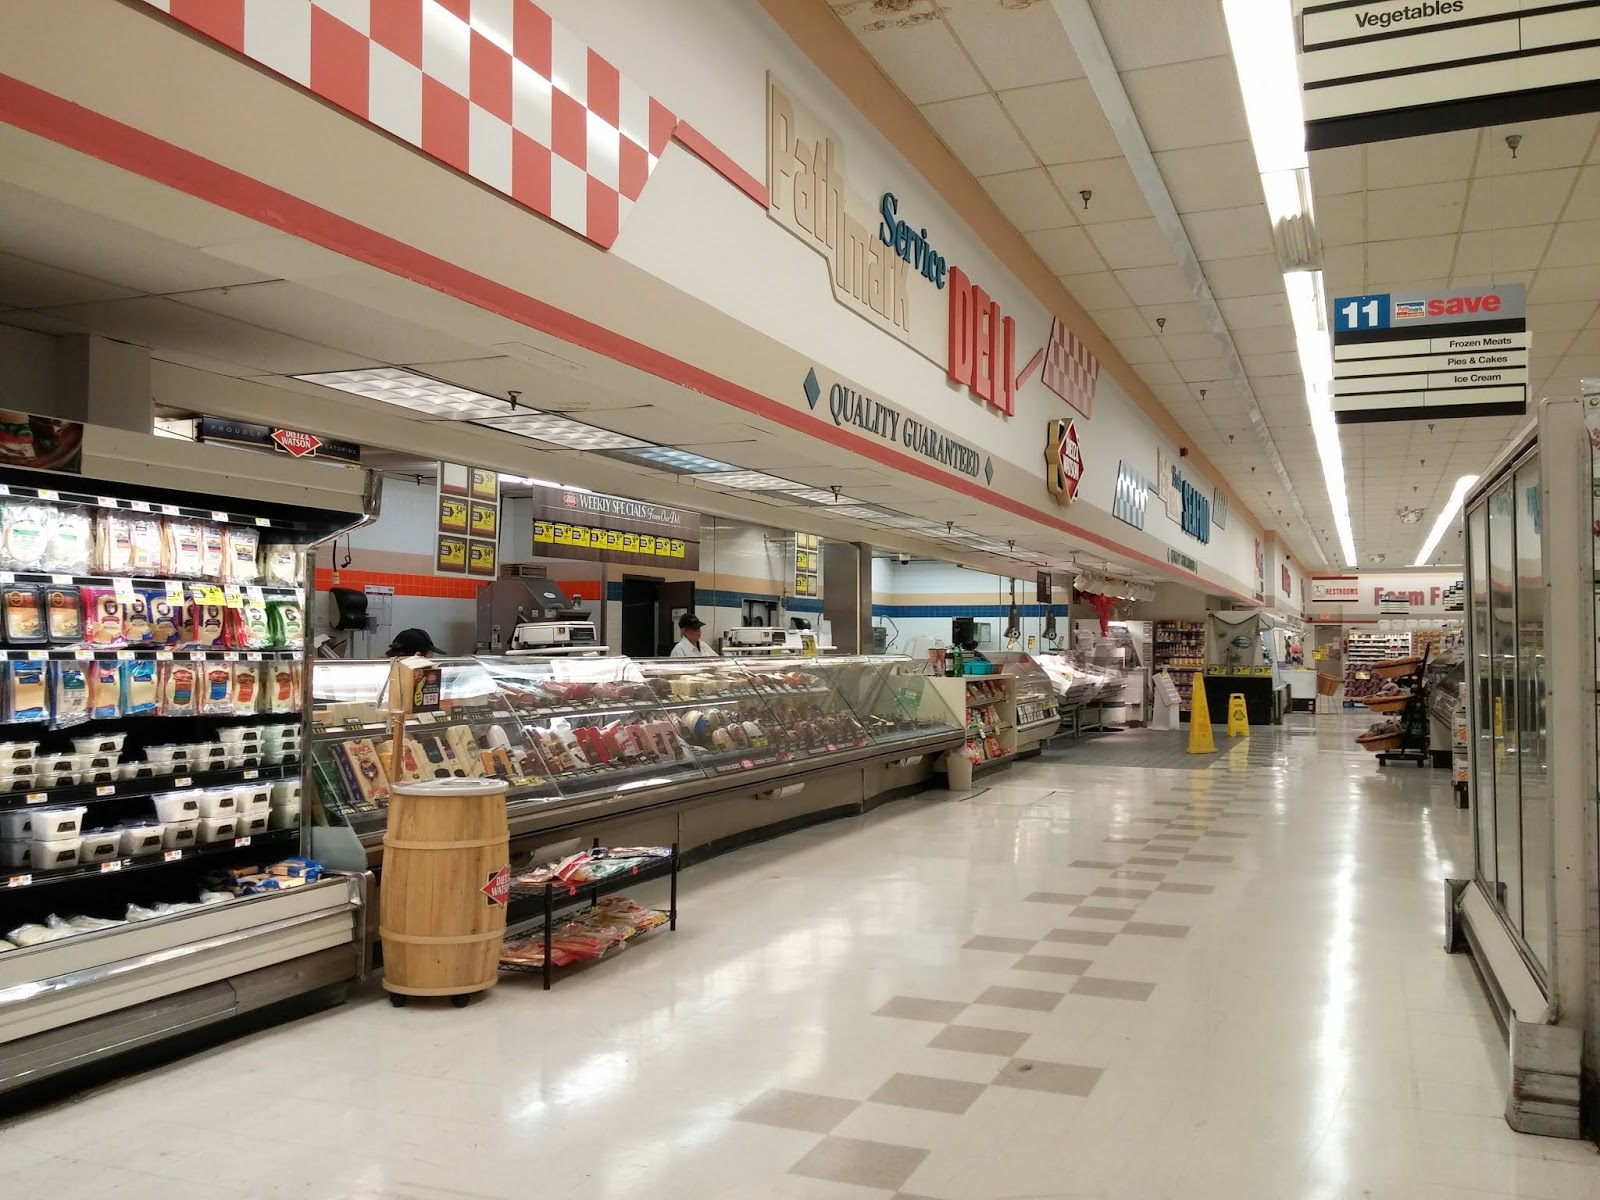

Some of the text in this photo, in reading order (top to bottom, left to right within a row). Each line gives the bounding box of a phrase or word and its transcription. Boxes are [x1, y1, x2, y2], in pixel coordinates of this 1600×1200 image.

[1355, 1, 1464, 28] Vegetables
[879, 192, 947, 290] Service
[1342, 300, 1379, 328] 11
[1428, 294, 1501, 317] save
[948, 265, 1016, 417] DELI
[1449, 336, 1512, 348] Frozen Meats
[1447, 355, 1508, 366] Pies & Cakes
[1454, 373, 1502, 383] Ice Cream
[210, 424, 262, 437] PROUDLY
[829, 382, 981, 478] QUALITY GUARANTEED
[281, 436, 311, 449] WATSON
[324, 443, 357, 455] EATURING
[580, 494, 611, 512] WEEKLY
[612, 500, 647, 518] SPECIALS
[1325, 588, 1359, 596] RESTROOMS
